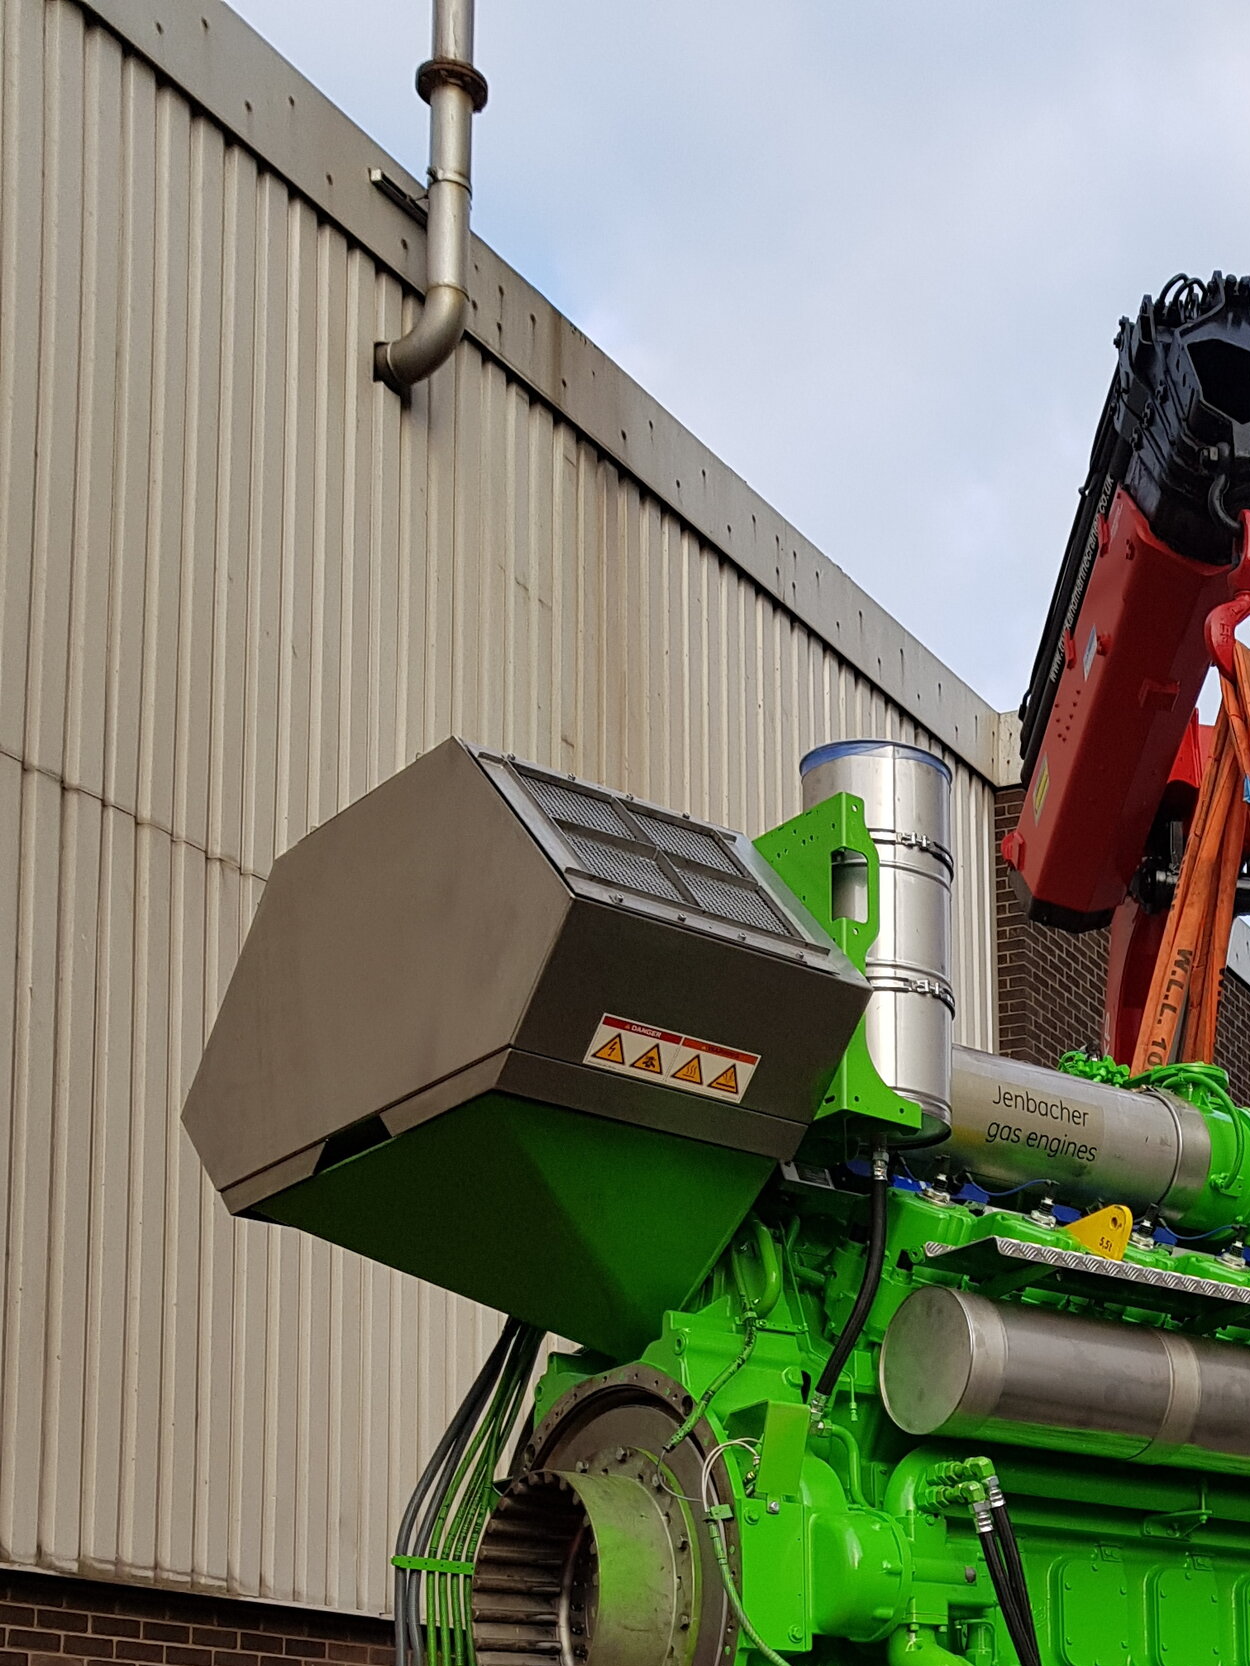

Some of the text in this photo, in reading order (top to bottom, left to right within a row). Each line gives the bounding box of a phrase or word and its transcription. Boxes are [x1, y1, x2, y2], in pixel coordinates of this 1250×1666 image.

[1157, 949, 1193, 1025] W.L.L.
[631, 1024, 662, 1038] DANGER
[992, 1085, 1090, 1128] Jenbacher
[985, 1119, 1098, 1162] gas engines
